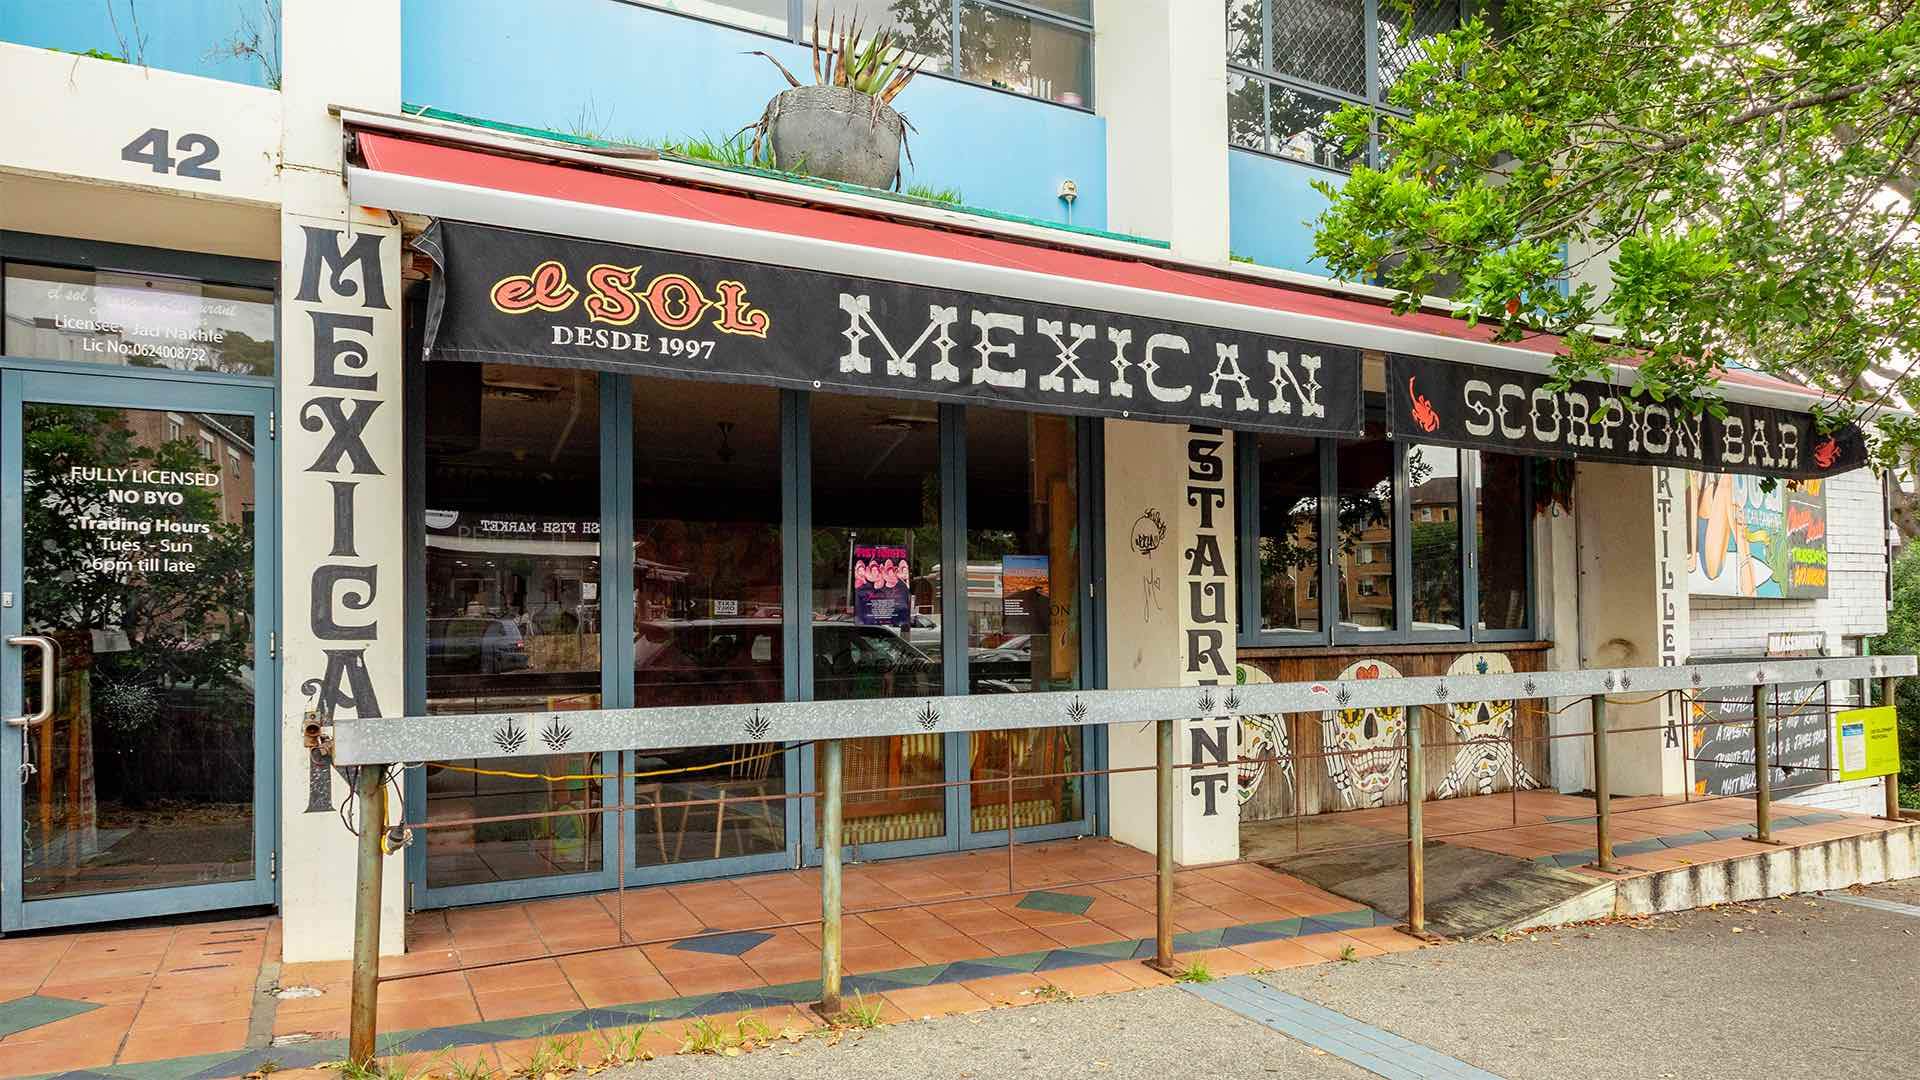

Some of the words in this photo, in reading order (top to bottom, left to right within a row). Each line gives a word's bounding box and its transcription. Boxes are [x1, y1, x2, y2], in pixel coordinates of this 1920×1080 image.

[121, 128, 221, 181] 42
[490, 262, 580, 314] el
[584, 264, 770, 339] SOL
[83, 338, 104, 352] Lic
[551, 325, 650, 352] DESDE
[659, 336, 716, 359] 1997
[839, 293, 1324, 419] MEXICAN
[1464, 379, 1702, 461] SCORPION
[1722, 415, 1799, 469] BAR
[71, 466, 128, 482] FULLY
[132, 470, 219, 486] LICENSED
[109, 489, 140, 504] NO
[144, 491, 184, 505] BYO
[78, 516, 152, 535] Trading
[156, 519, 210, 533] Hours
[100, 537, 141, 551] Tues
[160, 540, 193, 553] Sun
[92, 557, 133, 573] 6pm
[138, 559, 159, 572] till
[164, 559, 196, 573] late
